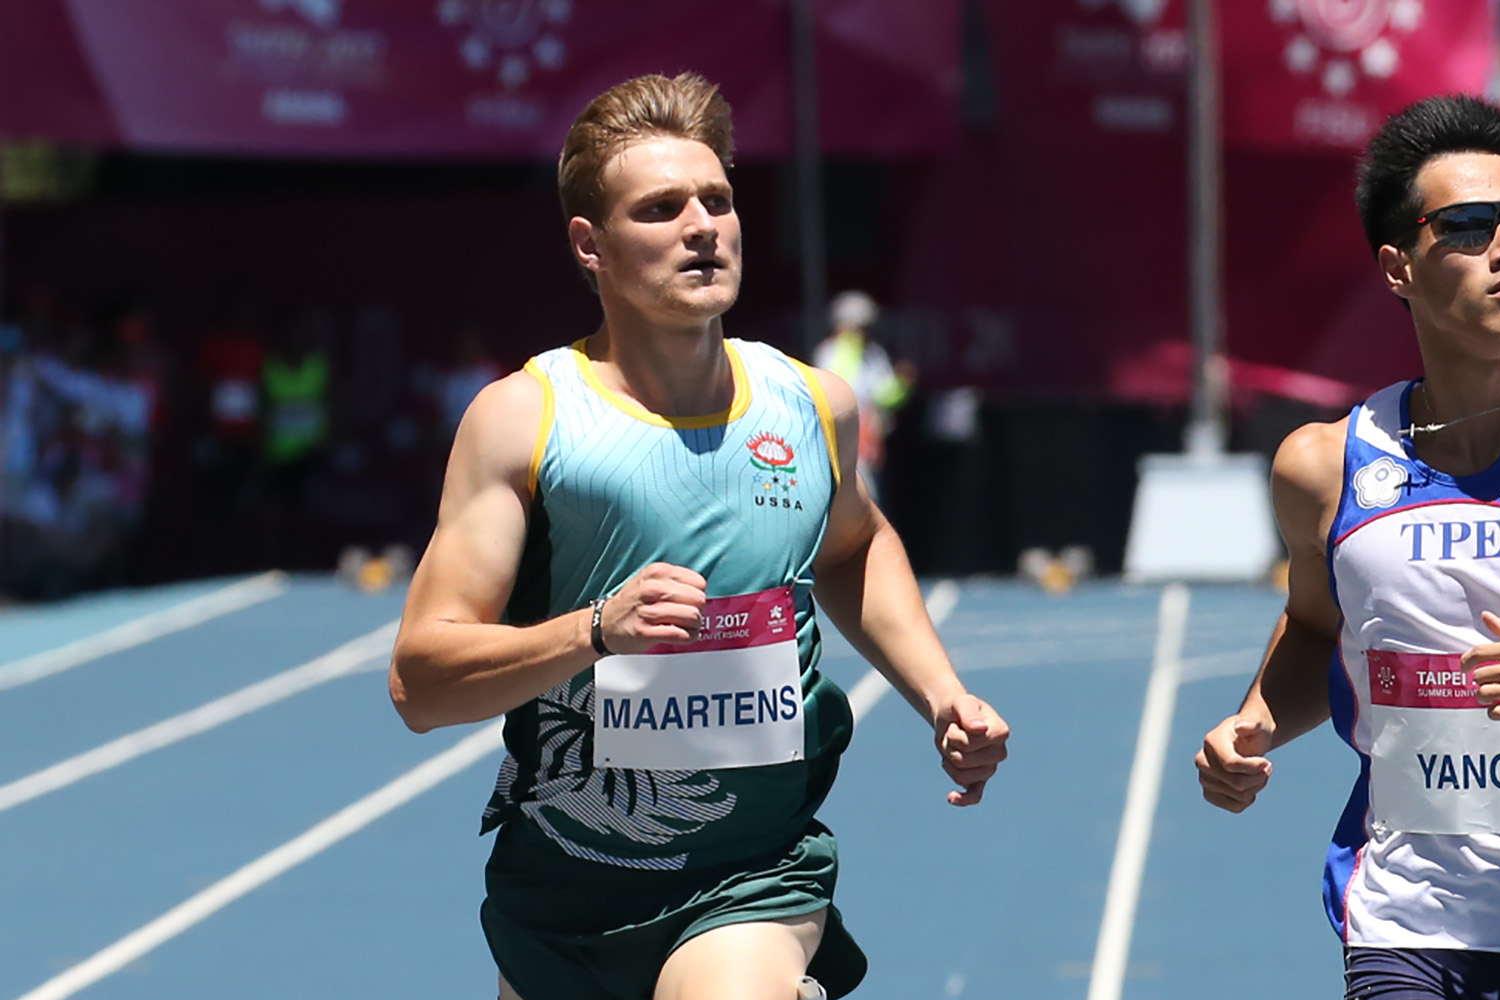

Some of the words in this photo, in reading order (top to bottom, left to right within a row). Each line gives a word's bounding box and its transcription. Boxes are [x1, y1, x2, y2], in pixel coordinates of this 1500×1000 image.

[755, 495, 803, 511] USSA
[715, 612, 750, 629] 2017
[1416, 671, 1467, 686] TAIPEI
[1418, 688, 1453, 697] SUMMER
[603, 685, 798, 731] MAARTENS
